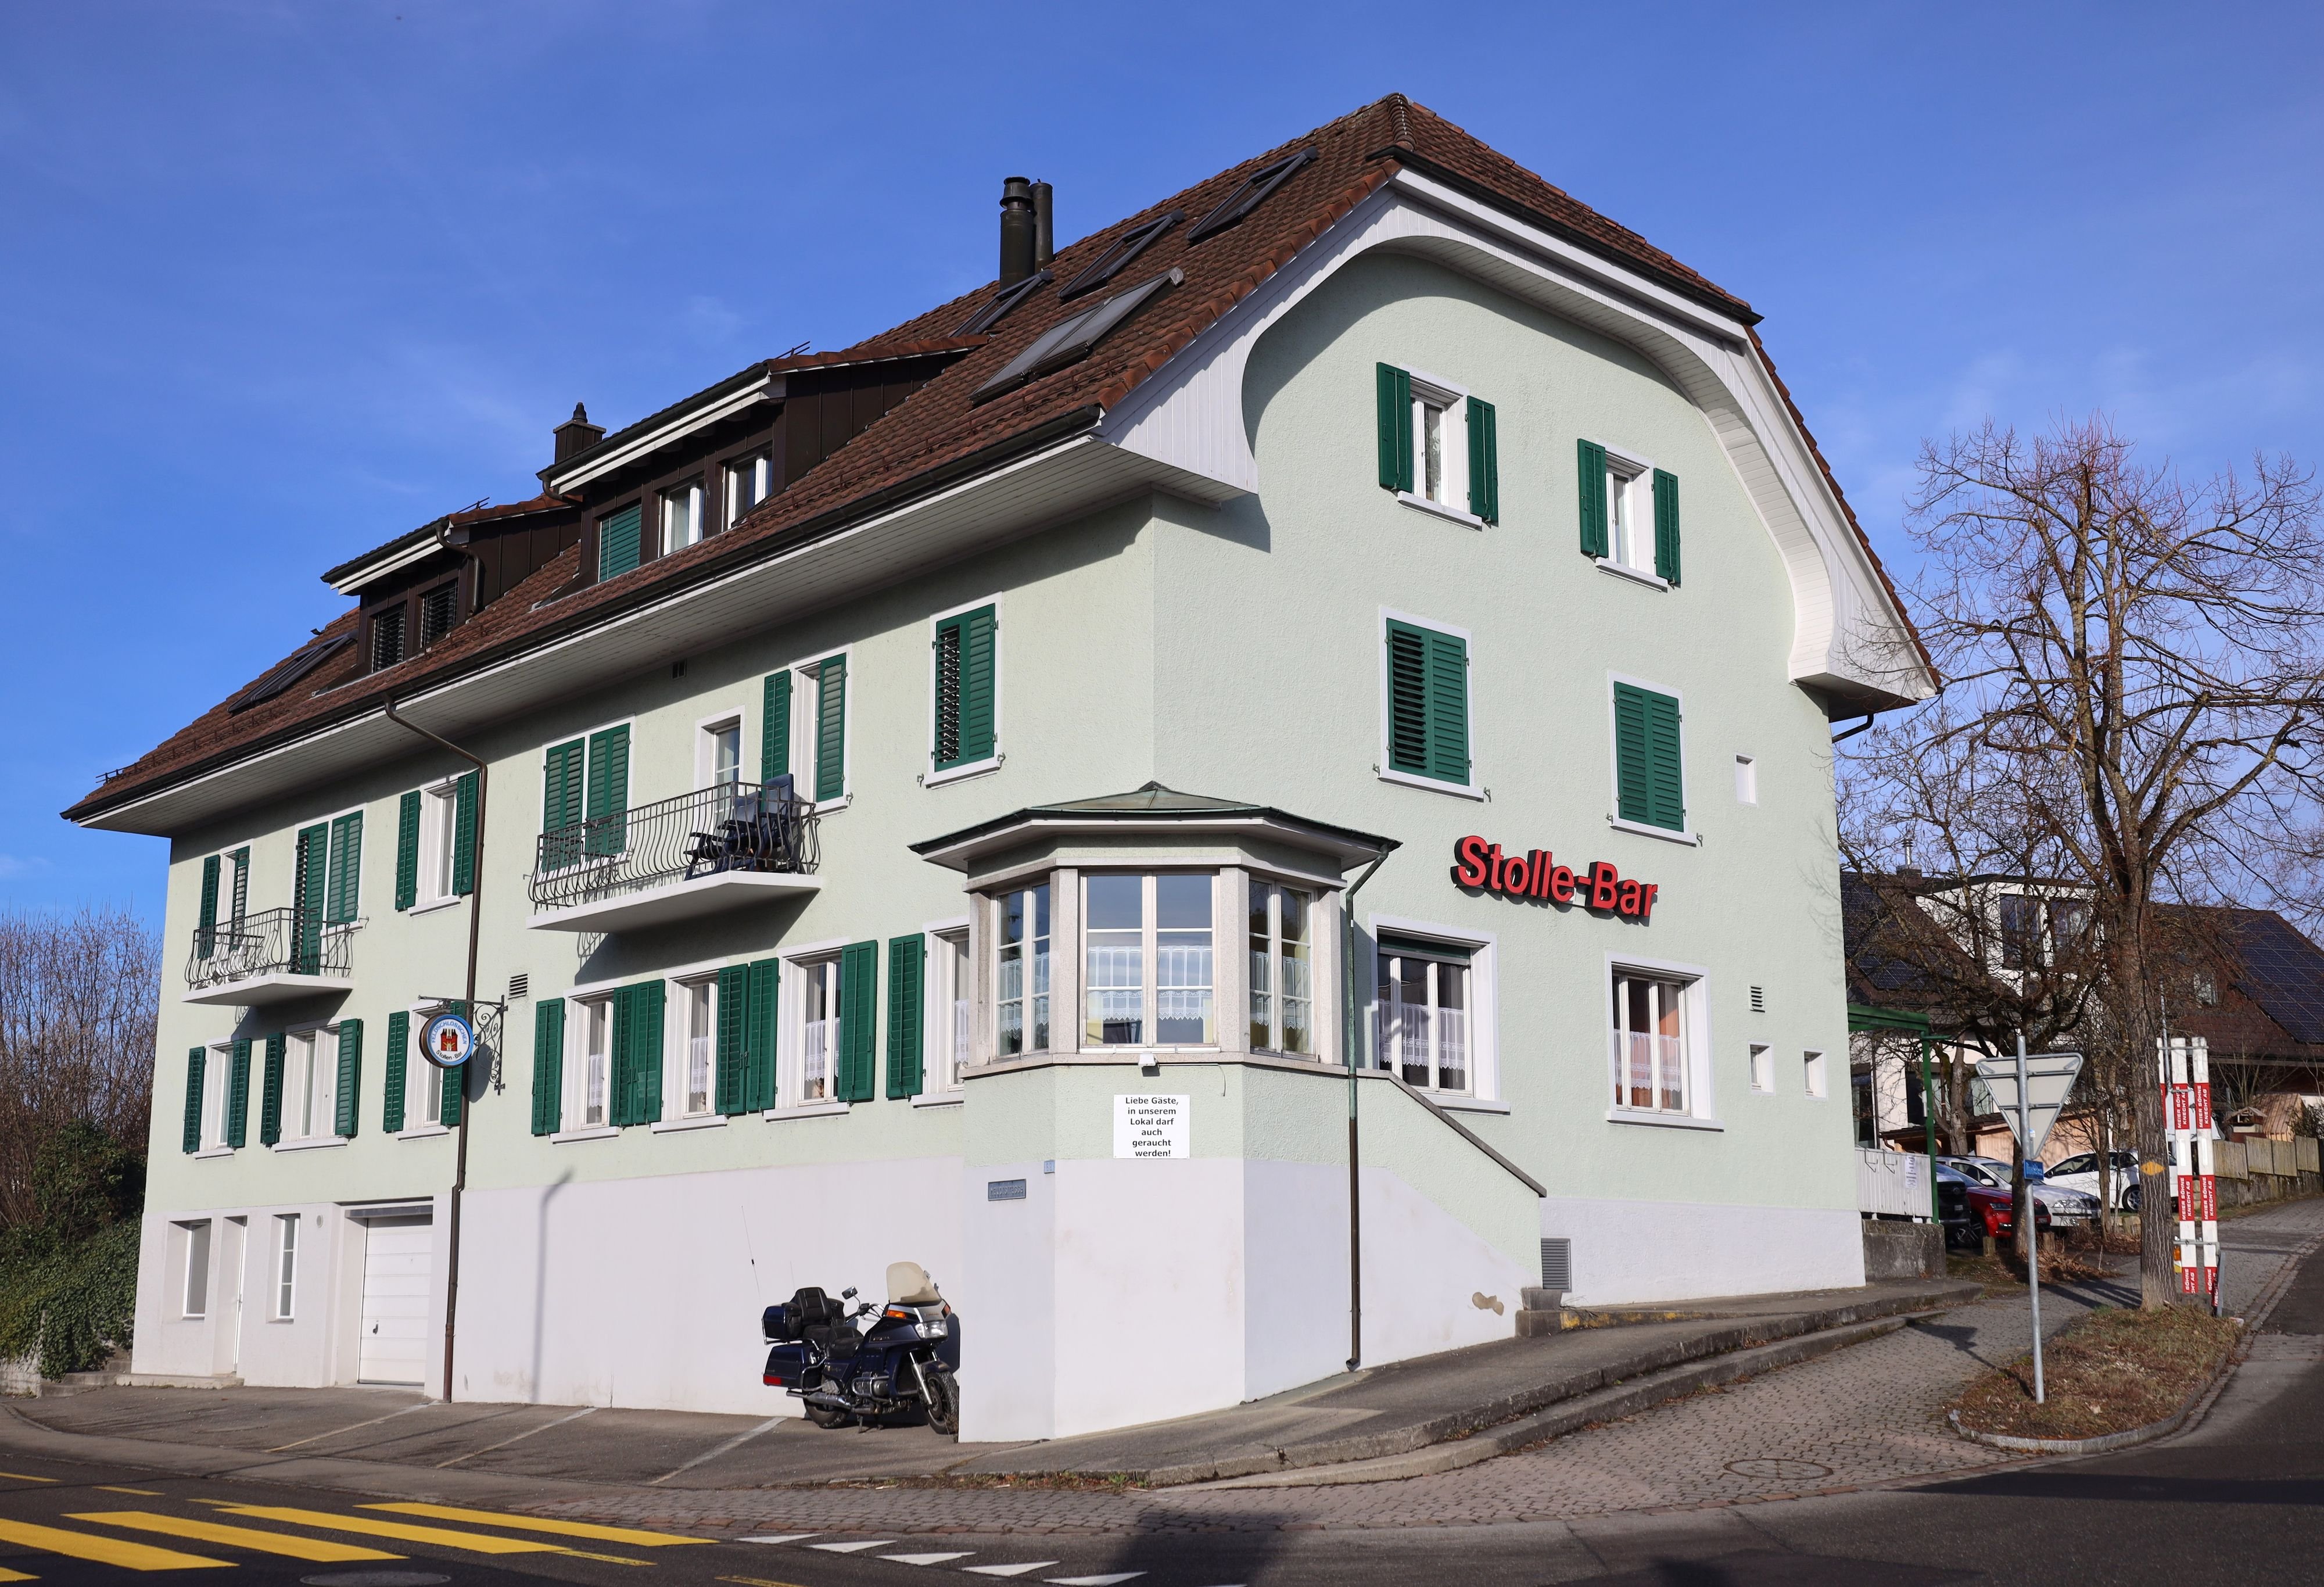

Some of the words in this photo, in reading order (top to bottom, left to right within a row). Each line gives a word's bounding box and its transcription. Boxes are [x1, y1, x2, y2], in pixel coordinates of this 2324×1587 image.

[1452, 835, 1658, 917] Stolle-Bar
[436, 1049, 452, 1060] Stollen
[2203, 1089, 2207, 1098] AG
[1152, 1097, 1179, 1105] Gäste,
[1132, 1139, 1171, 1148] geraucht
[2186, 1181, 2190, 1190] AG
[2208, 1181, 2212, 1190] AG
[2190, 1272, 2194, 1281] AG
